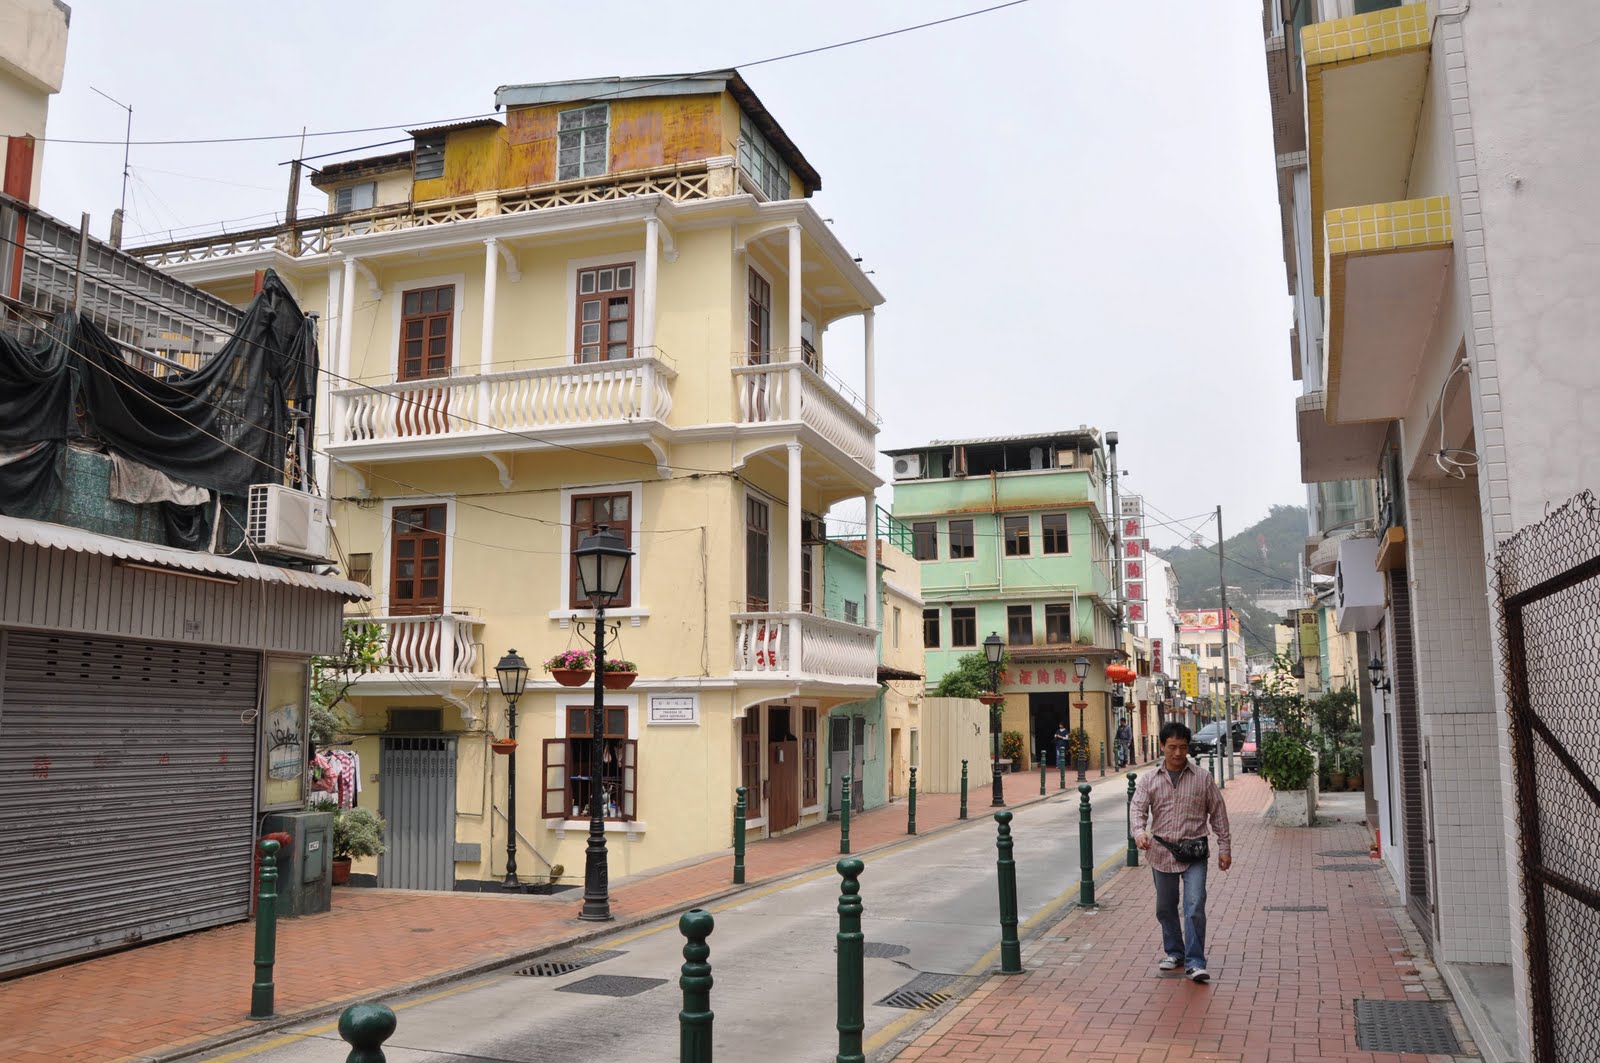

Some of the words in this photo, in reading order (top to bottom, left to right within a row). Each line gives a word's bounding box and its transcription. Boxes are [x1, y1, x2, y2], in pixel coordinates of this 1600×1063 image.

[1124, 519, 1143, 621] 新陶陶酒家
